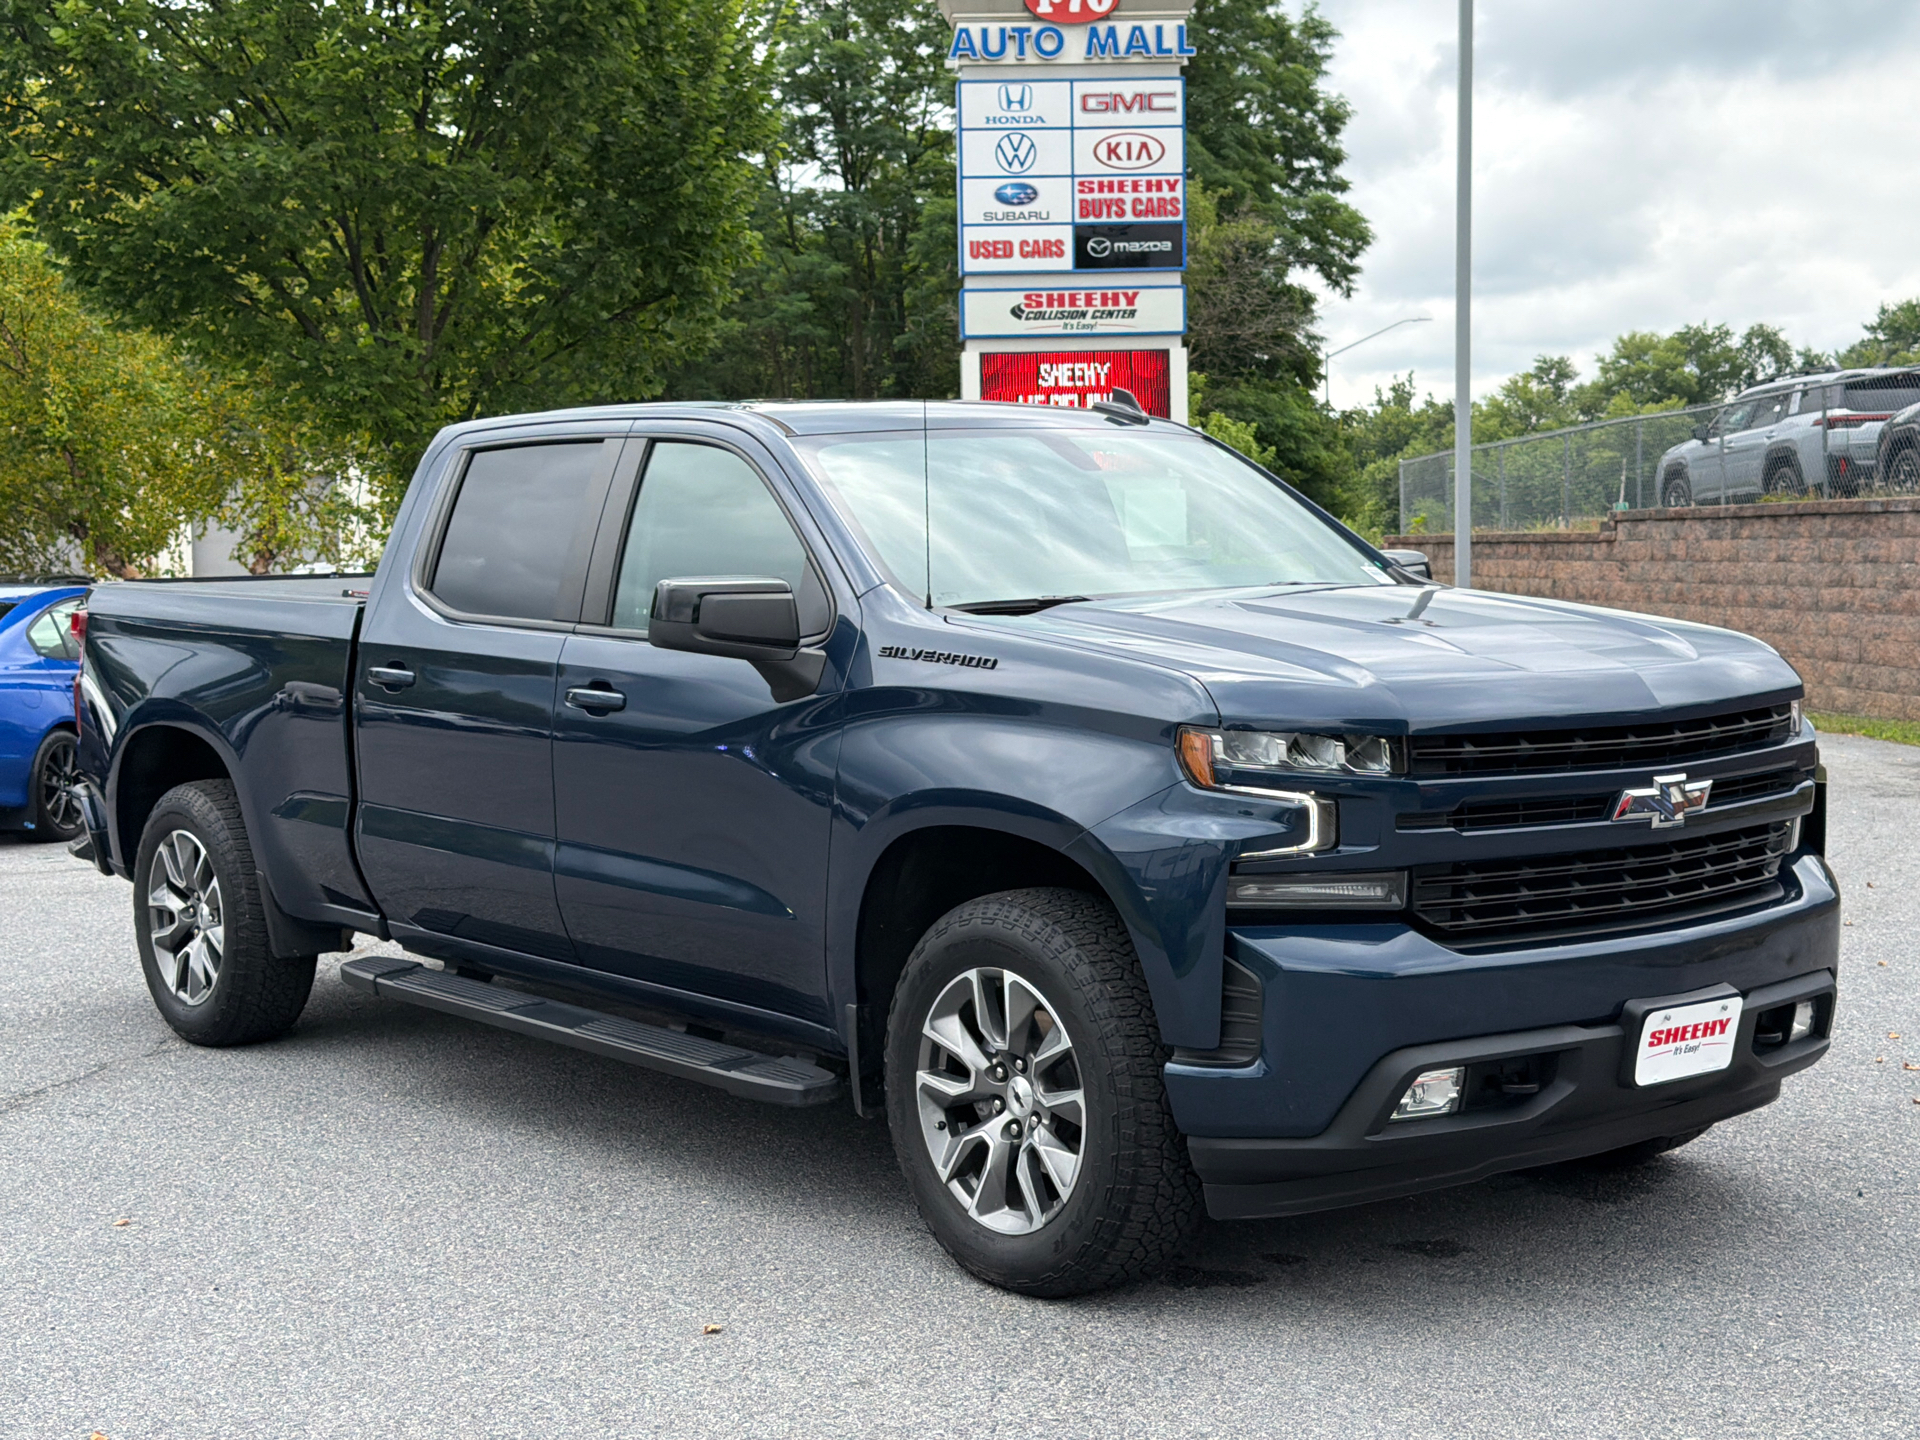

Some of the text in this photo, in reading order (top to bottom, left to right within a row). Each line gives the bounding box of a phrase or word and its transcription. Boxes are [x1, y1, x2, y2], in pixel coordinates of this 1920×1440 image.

[949, 25, 1196, 59] AUTO MALL
[1080, 91, 1177, 113] GMC
[985, 116, 1046, 125] HONDA
[1106, 142, 1153, 161] KIA
[1077, 179, 1181, 194] SHEEHY
[983, 211, 1050, 221] SUBARU
[1079, 197, 1181, 219] BUYS CARS
[969, 239, 1065, 259] USED CARS
[1113, 241, 1173, 252] mazda
[1023, 291, 1139, 309] SHEEHY
[1024, 309, 1137, 321] COLLISION CENTER
[1062, 321, 1098, 331] It's Easy!
[1038, 362, 1111, 387] SHEEHY
[878, 646, 998, 670] SILVERADO
[1648, 1017, 1732, 1048] SHEEHY
[1673, 1041, 1702, 1056] It's Easy!
